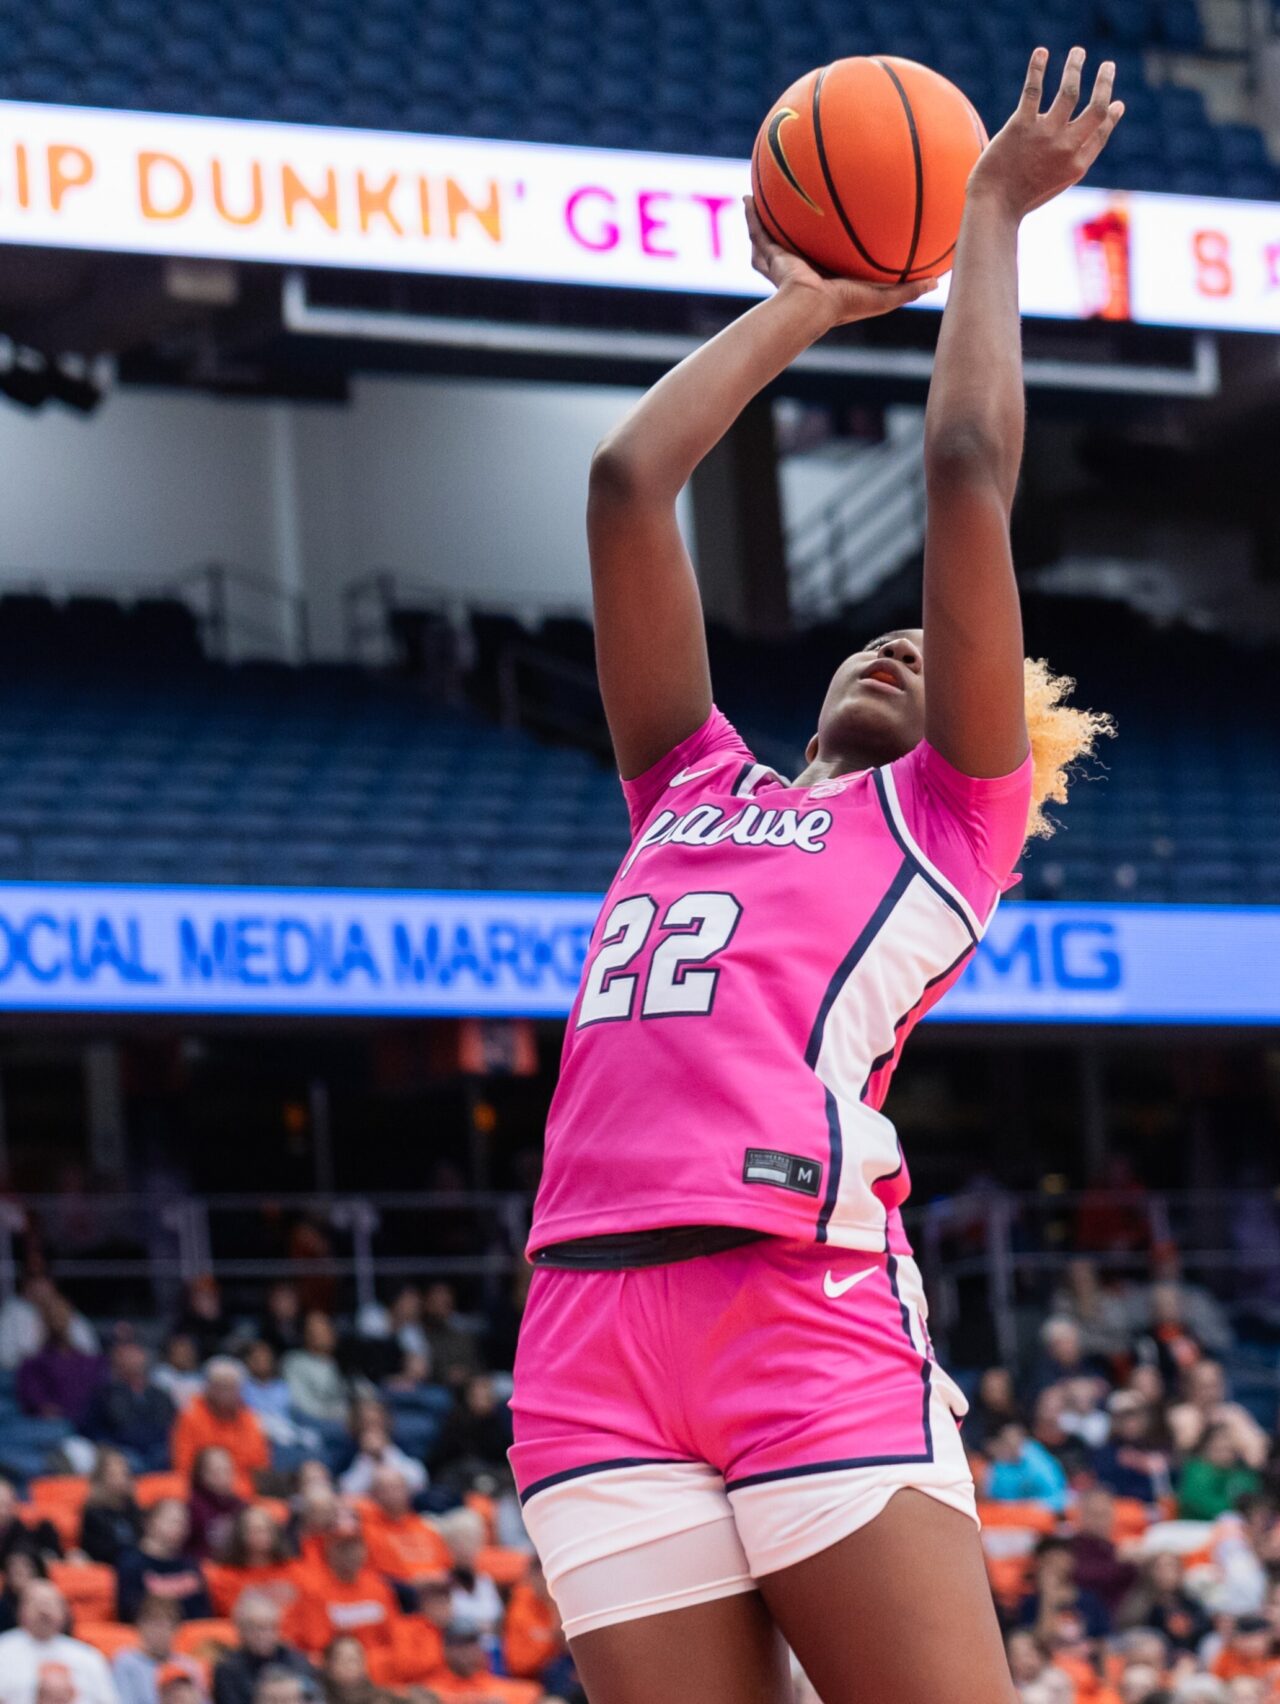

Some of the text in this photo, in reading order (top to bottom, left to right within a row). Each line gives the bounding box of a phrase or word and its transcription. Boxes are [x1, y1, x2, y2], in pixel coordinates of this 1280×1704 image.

[0, 142, 735, 260] IP DUNKIN' GET
[179, 914, 382, 986] MEDIA
[575, 890, 744, 1032] 22
[797, 1166, 814, 1184] M
